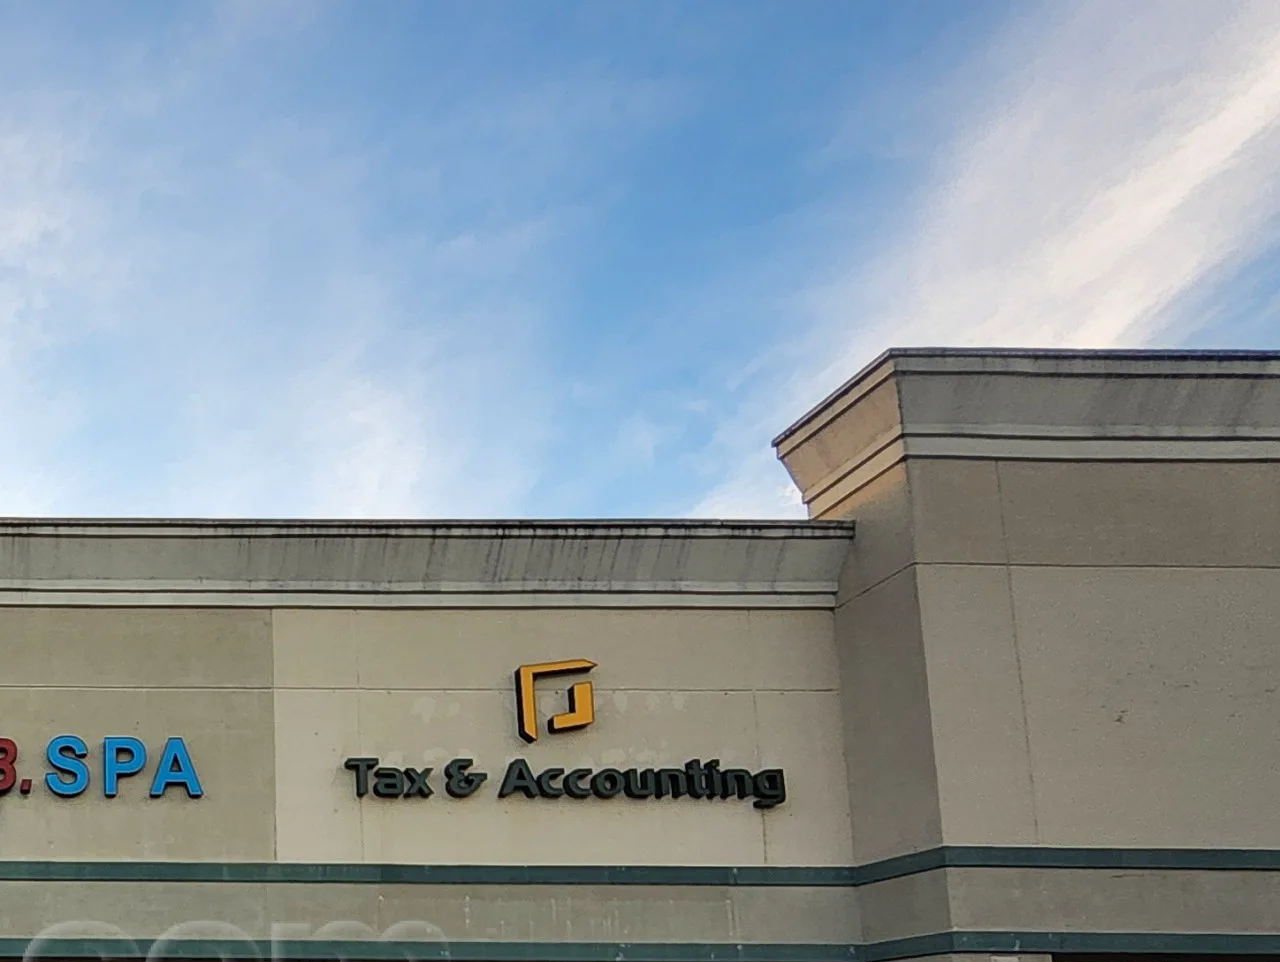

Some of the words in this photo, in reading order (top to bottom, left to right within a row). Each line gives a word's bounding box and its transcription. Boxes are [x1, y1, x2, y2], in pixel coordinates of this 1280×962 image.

[44, 735, 204, 798] SPA
[344, 757, 435, 798] Tax
[443, 758, 488, 798] &
[498, 757, 786, 809] Accounting
